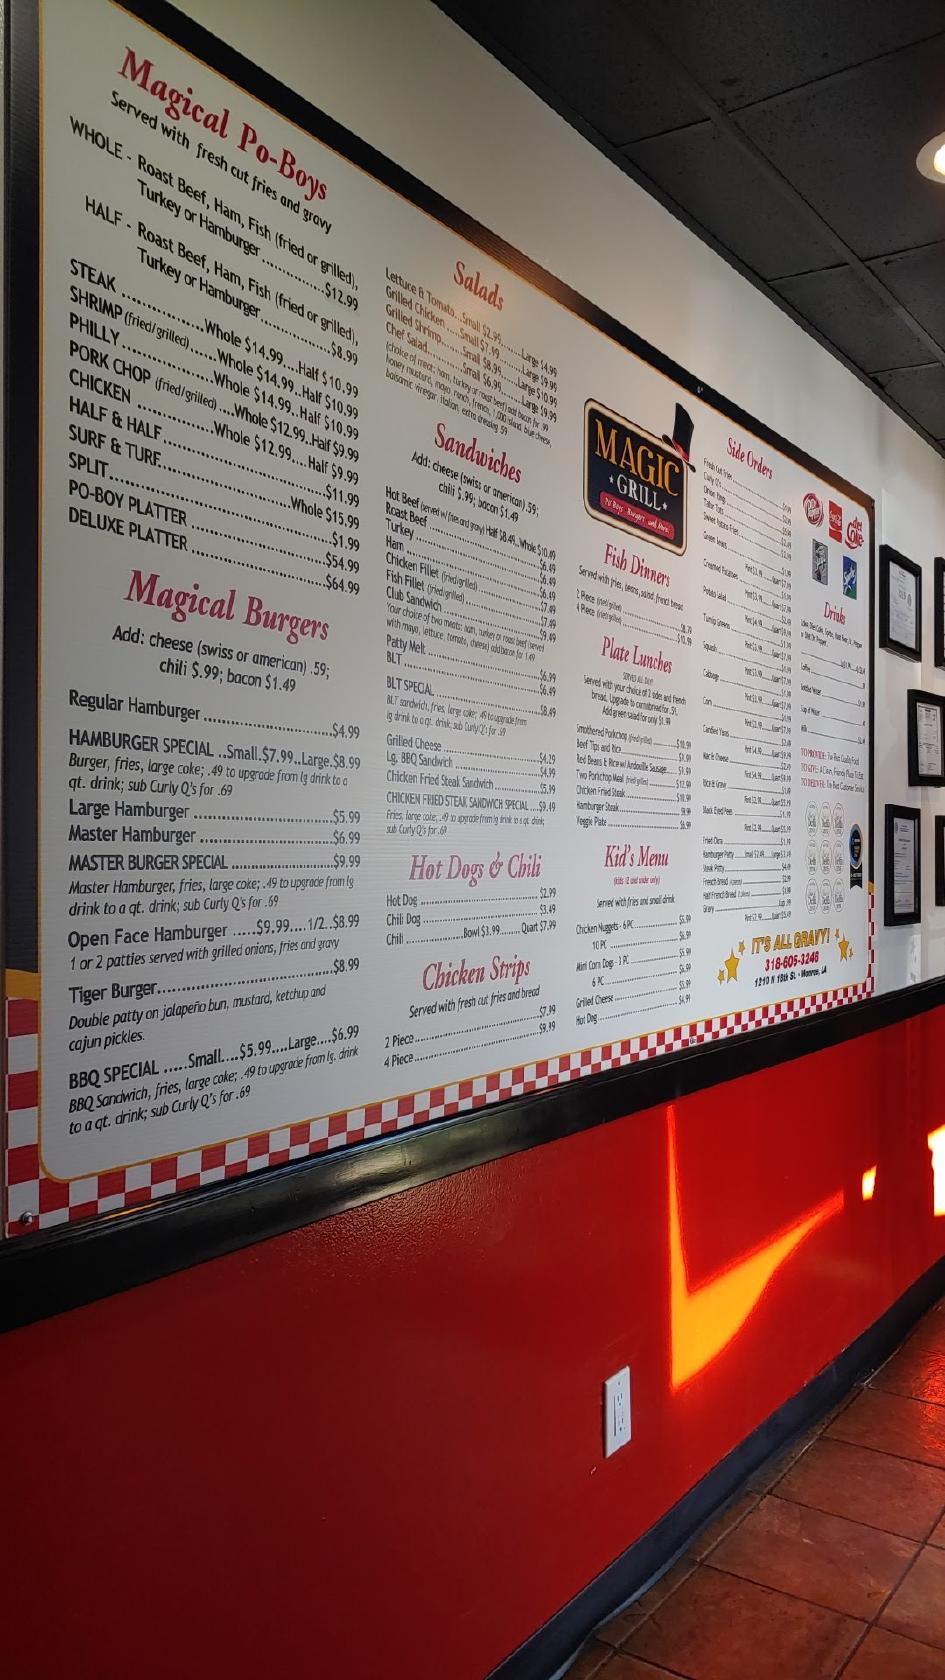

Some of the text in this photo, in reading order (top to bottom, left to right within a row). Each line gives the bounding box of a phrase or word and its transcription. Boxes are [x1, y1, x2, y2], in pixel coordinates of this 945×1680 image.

[118, 46, 327, 201] Magical Po-Boys
[110, 90, 332, 235] Served with fresh cut fries and gravy
[69, 116, 358, 291] WHOLE Roast Beef, Ham, Fish (fried or grilled),
[137, 178, 181, 218] Turkey
[184, 208, 197, 223] or
[325, 281, 358, 311] $12.99
[70, 258, 116, 294] STEAK
[453, 261, 503, 311] Salads
[70, 285, 123, 320] SHRIMP
[385, 285, 444, 328] Grilled Chicken
[69, 311, 120, 346] PHILLY
[69, 339, 151, 384] PORK CHOP
[69, 368, 131, 404] CHICKEN
[69, 423, 106, 449] SURF
[110, 437, 121, 456] &
[69, 395, 359, 508] HALF & HALF $11.99
[434, 422, 521, 483] Sandwiches
[69, 451, 109, 478] SPLIT
[595, 418, 680, 497] MAGIC
[726, 437, 772, 479] Side Orders
[438, 481, 455, 497] chili
[477, 496, 498, 515] bacon
[616, 474, 662, 511] GRILL
[69, 479, 359, 574] PO-BOY PLATTER $54.99
[385, 501, 428, 528] Roast Beef
[385, 517, 414, 541] Turkey
[69, 506, 360, 595] DELUXE PLATTER $64.99
[385, 534, 404, 552] Ham
[385, 551, 439, 579] Chicken Fillet
[603, 543, 670, 588] Fish Dinners
[123, 569, 329, 645] Magical Burgers
[386, 585, 442, 612] Club Sandwich
[823, 602, 846, 625] Drinks
[112, 625, 306, 676] Add: cheese (swiss or american)
[386, 634, 426, 655] Patty Melt
[601, 635, 672, 674] Plate Lunches
[159, 657, 188, 676] chili
[226, 667, 262, 687] bacon
[265, 673, 296, 692] $1.49
[386, 675, 434, 696] BLT SPECIAL
[69, 689, 200, 723] Regular Hamburger
[69, 728, 214, 757] HAMBURGER SPECIAL
[576, 784, 625, 797] Chicken Fried Steak
[604, 801, 619, 812] Steak
[69, 798, 190, 823] Large Hamburger
[594, 815, 607, 826] Plate
[68, 824, 196, 846] Master Hamburger
[68, 854, 228, 871] MASTER BURGER SPECIAL
[408, 851, 541, 887] Hot Dogs & Chili
[636, 845, 668, 866] Menu
[386, 893, 417, 908] Hot Dog
[386, 912, 421, 927] Chili Dog
[575, 921, 619, 934] Chicken Nuggets
[67, 924, 228, 951] Open Face Hamburger
[751, 928, 830, 955] IT'S ALL GRAVY!
[105, 943, 243, 971] patties served with grilled
[422, 954, 530, 991] Chicken Strips
[68, 982, 158, 1006] Tiger Burger
[408, 984, 540, 1018] Served with fries and bread
[594, 994, 613, 1005] Cheese
[69, 1011, 110, 1030] Double
[112, 1009, 144, 1028] patty
[575, 1012, 597, 1025] Hot Dog
[69, 1059, 159, 1089] BBQ SPECIAL
